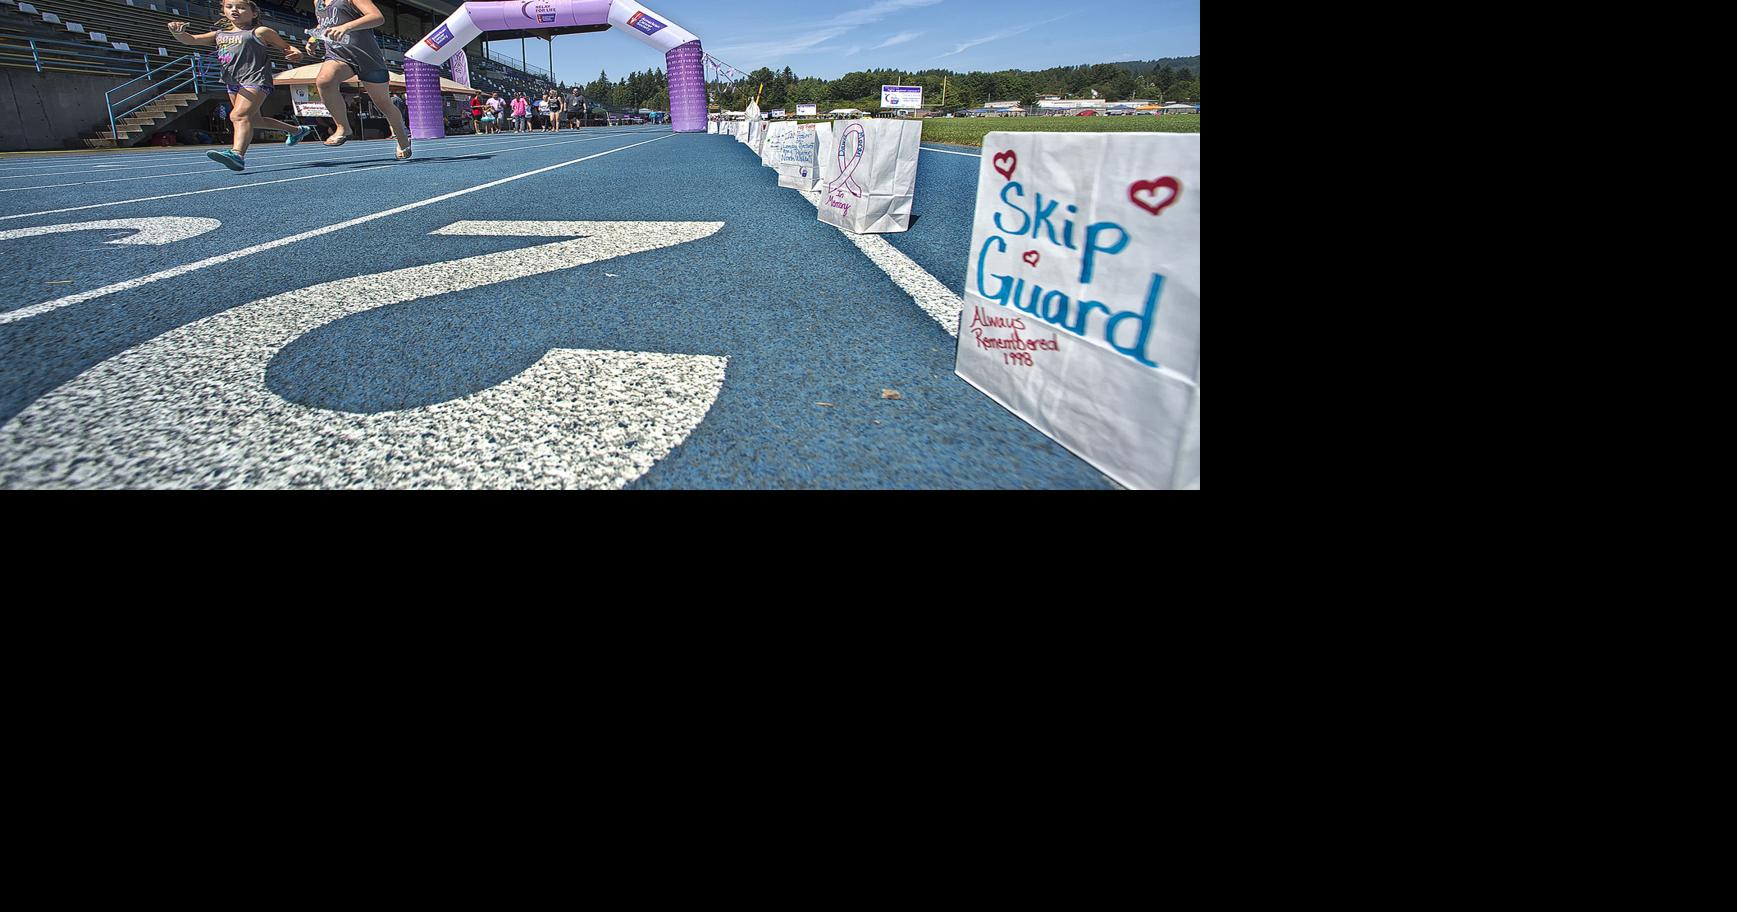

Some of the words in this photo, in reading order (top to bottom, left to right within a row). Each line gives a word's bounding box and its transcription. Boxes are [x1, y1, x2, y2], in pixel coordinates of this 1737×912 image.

[825, 195, 851, 216] Memory
[836, 190, 844, 198] In
[993, 181, 1131, 284] Skip
[976, 235, 1166, 368] Guard
[970, 306, 1026, 331] Always
[970, 327, 1060, 352] Remembered
[1003, 351, 1034, 366] 1998
